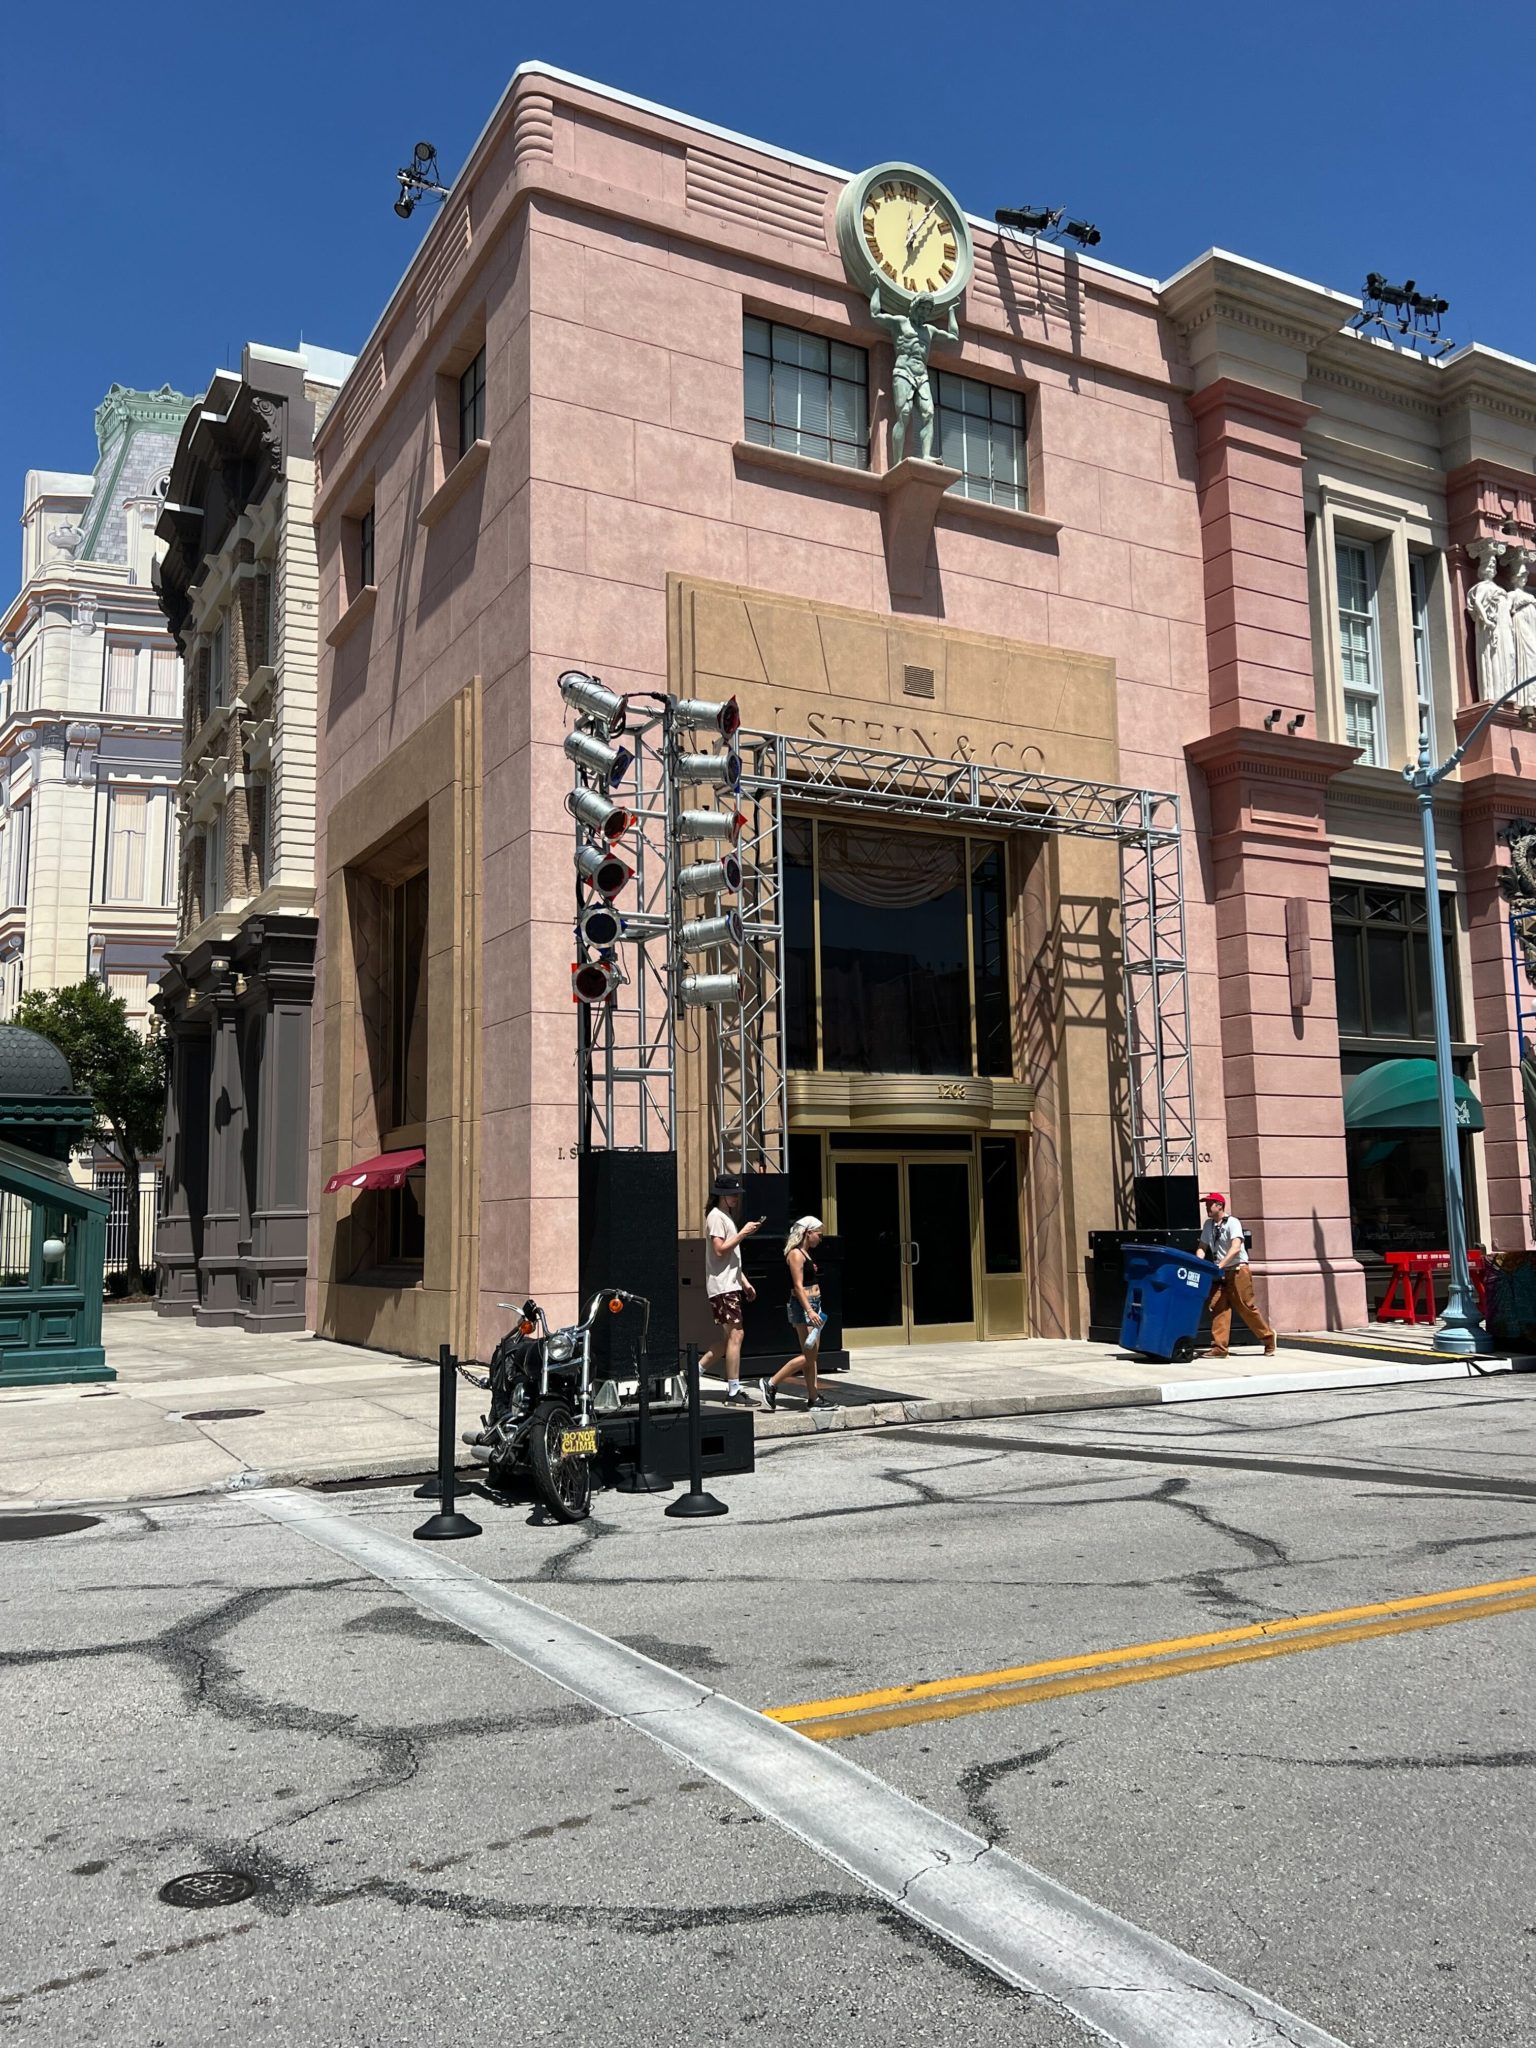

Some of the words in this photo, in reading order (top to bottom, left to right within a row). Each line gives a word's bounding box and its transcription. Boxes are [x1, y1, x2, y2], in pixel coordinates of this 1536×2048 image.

[951, 735, 977, 766] &
[1198, 1152, 1213, 1163] CO.
[563, 1432, 576, 1441] DO
[578, 1430, 595, 1441] NOT
[562, 1440, 596, 1453] CLIMB
